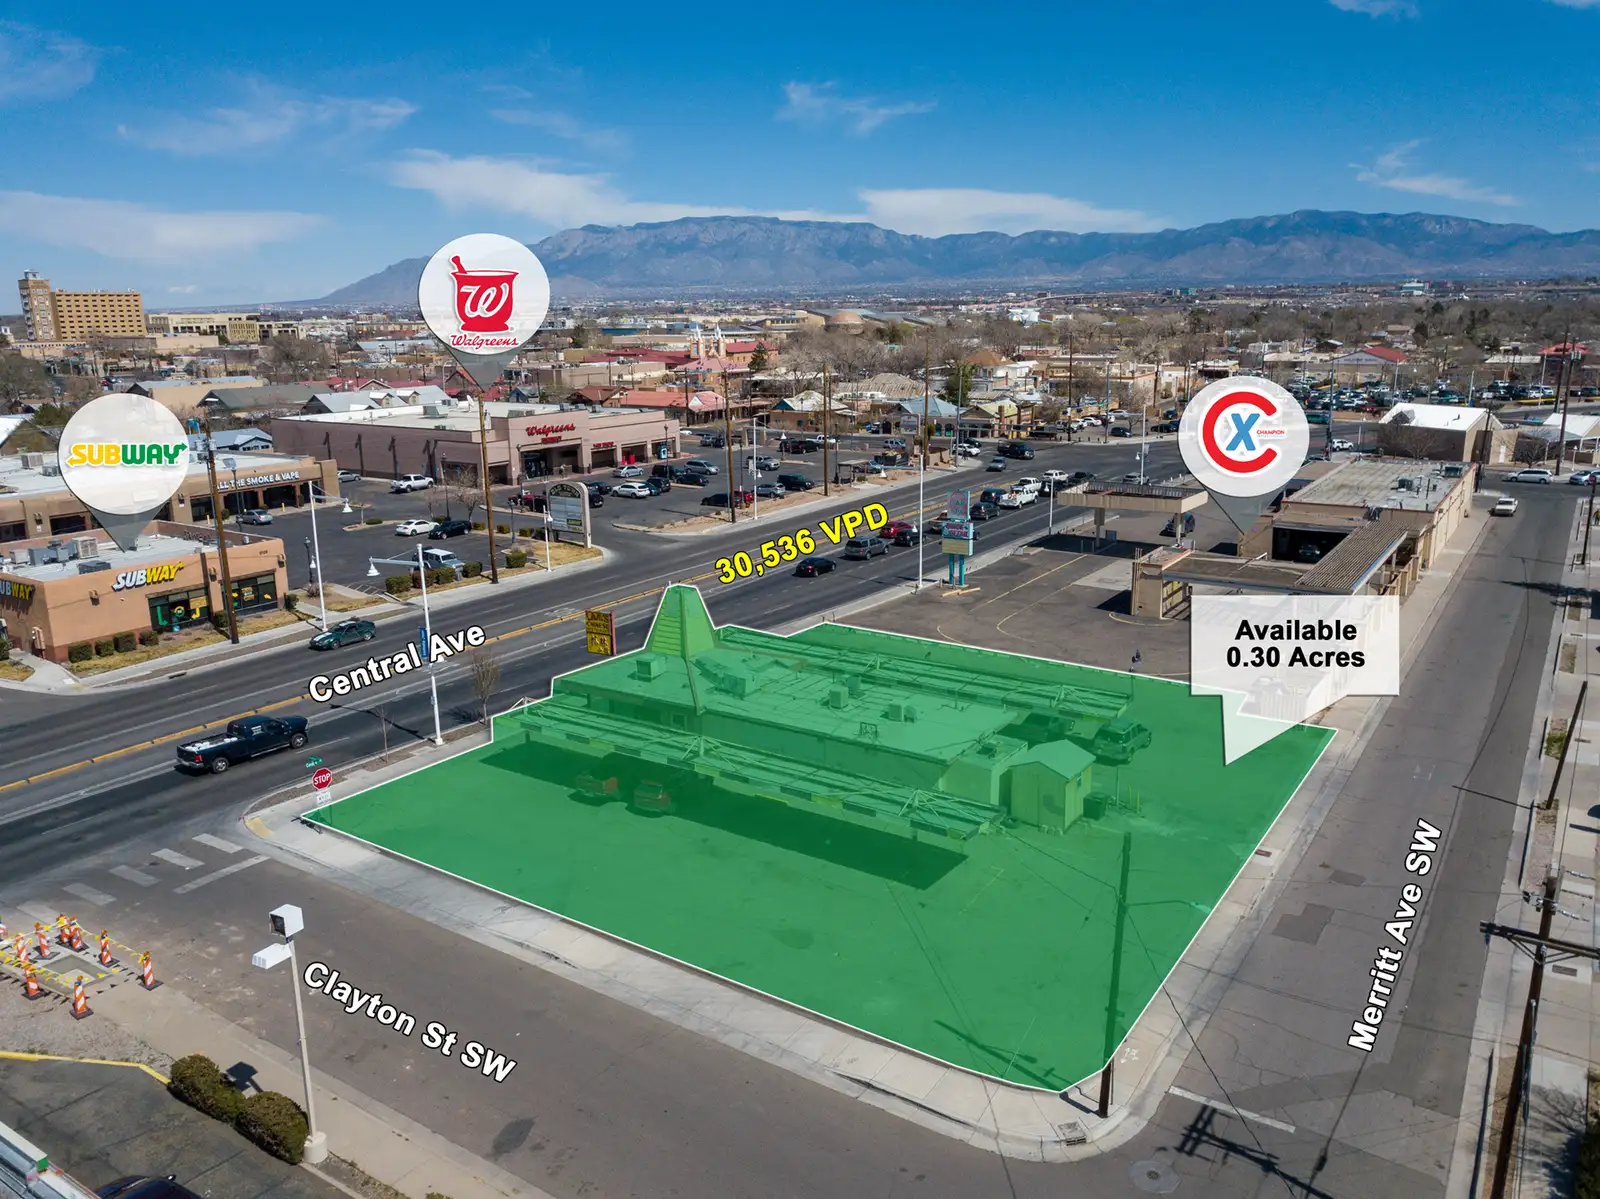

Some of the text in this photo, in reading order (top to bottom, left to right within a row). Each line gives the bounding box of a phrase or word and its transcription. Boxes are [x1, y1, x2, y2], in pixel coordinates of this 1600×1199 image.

[525, 423, 576, 437] Walgreens
[230, 478, 245, 487] THE
[246, 474, 274, 485] SMOKE
[275, 473, 281, 481] &
[281, 471, 300, 481] VAPE
[112, 561, 185, 592] SUBWAY
[0, 580, 35, 600] UBWAY
[314, 773, 331, 785] STOP
